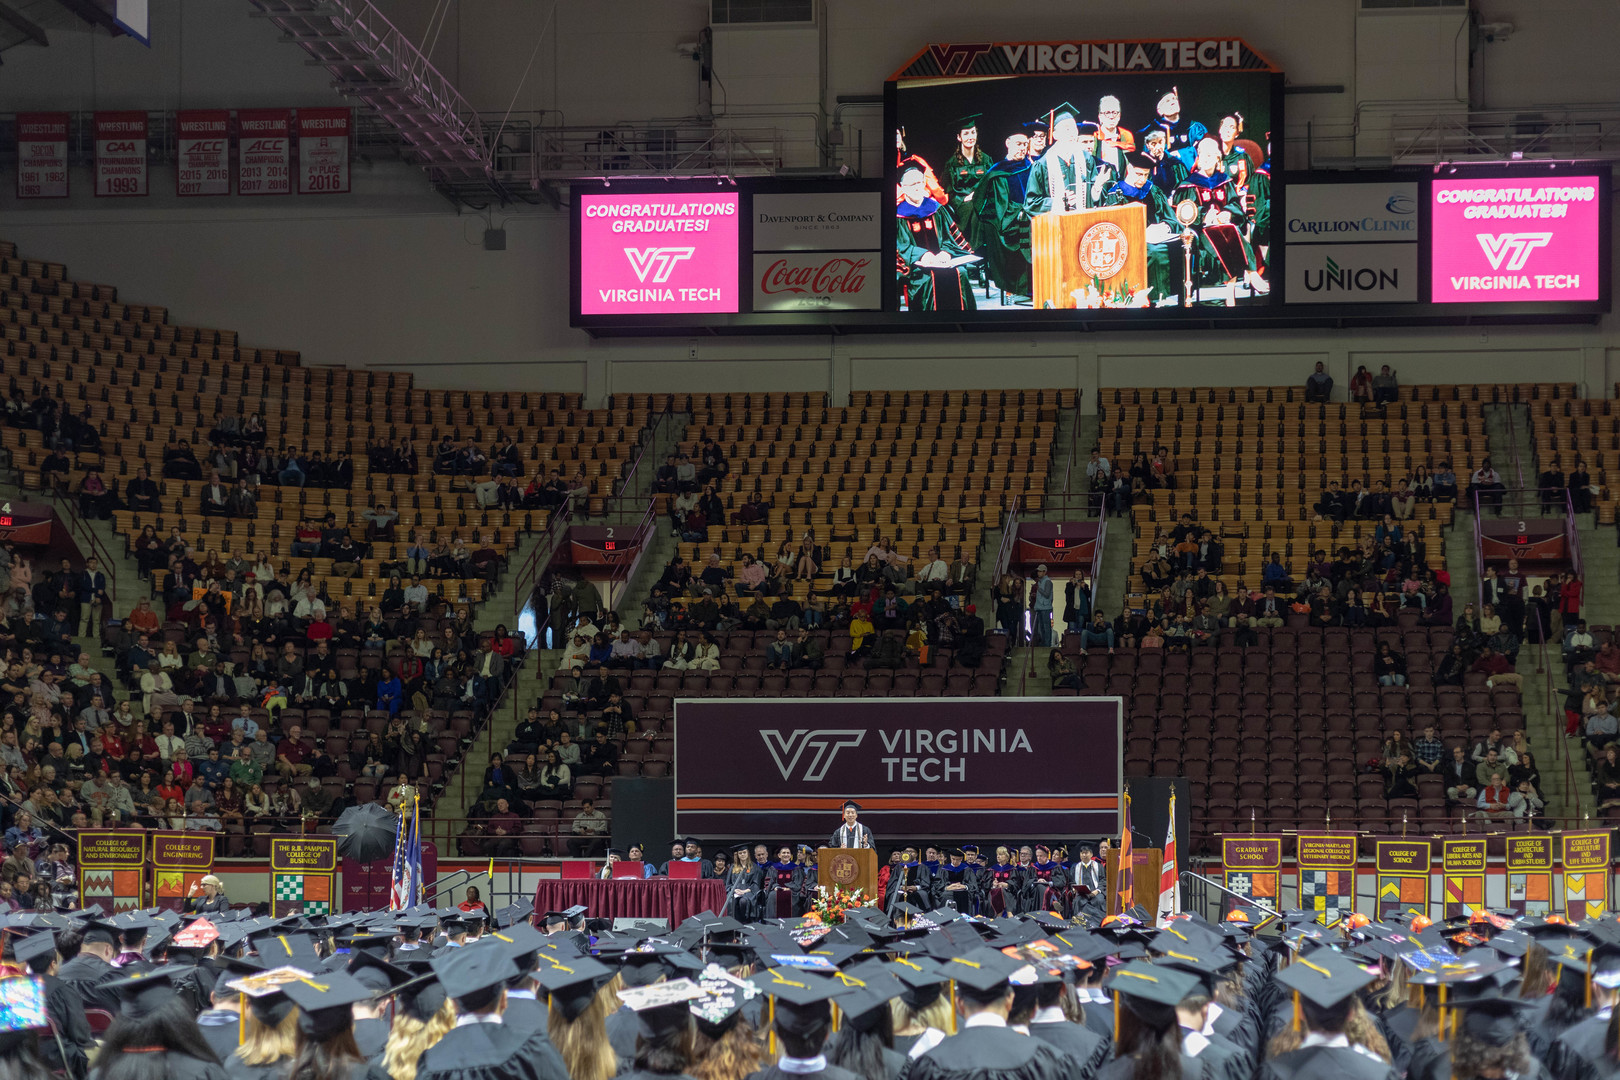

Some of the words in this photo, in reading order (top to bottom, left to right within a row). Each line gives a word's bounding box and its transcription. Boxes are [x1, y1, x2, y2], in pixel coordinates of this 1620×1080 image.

[1003, 42, 1152, 71] VIRGINIA
[1161, 41, 1240, 68] TECH
[20, 124, 65, 134] WRESTLING
[98, 121, 143, 132] WRESTLING
[181, 121, 226, 131] WRESTLING
[241, 120, 287, 130] WRESTLING
[301, 119, 347, 130] WRESTLING
[106, 142, 136, 152] CAA
[187, 141, 224, 152] ACC
[246, 140, 284, 151] ACC
[24, 159, 63, 167] CHAMPIONS
[99, 157, 144, 165] TOURNAMENT
[245, 156, 284, 164] CHAMPIONS
[180, 170, 201, 180] 2015
[206, 169, 227, 180] 2016
[241, 168, 261, 178] 2013
[266, 167, 288, 177] 2014
[319, 165, 340, 174] PLACE
[21, 172, 40, 182] 1961
[308, 174, 340, 191] 2016
[105, 178, 138, 193] 1993
[179, 182, 201, 193] 2017
[241, 181, 261, 191] 2017
[267, 179, 288, 190] 2018
[1437, 187, 1594, 203] CONGRATULATIONS
[586, 203, 735, 218] CONGRATULATIONS
[1464, 204, 1568, 219] GRADUATES!
[612, 219, 710, 233] GRADUATES!
[1476, 232, 1553, 270] VT
[623, 247, 696, 283] VT
[761, 258, 872, 294] Coca-Cola
[1304, 266, 1398, 291] UNION
[1451, 275, 1531, 290] VIRGINIA
[1534, 274, 1580, 289] TECH
[599, 289, 675, 302] VIRGINIA
[679, 288, 721, 301] TECH
[1, 502, 12, 514] 4
[1056, 524, 1062, 535] 1
[1518, 521, 1526, 532] 3
[606, 528, 614, 538] 2
[759, 729, 867, 782] VT
[878, 729, 1033, 754] VIRGINIA
[881, 757, 965, 782] TECH
